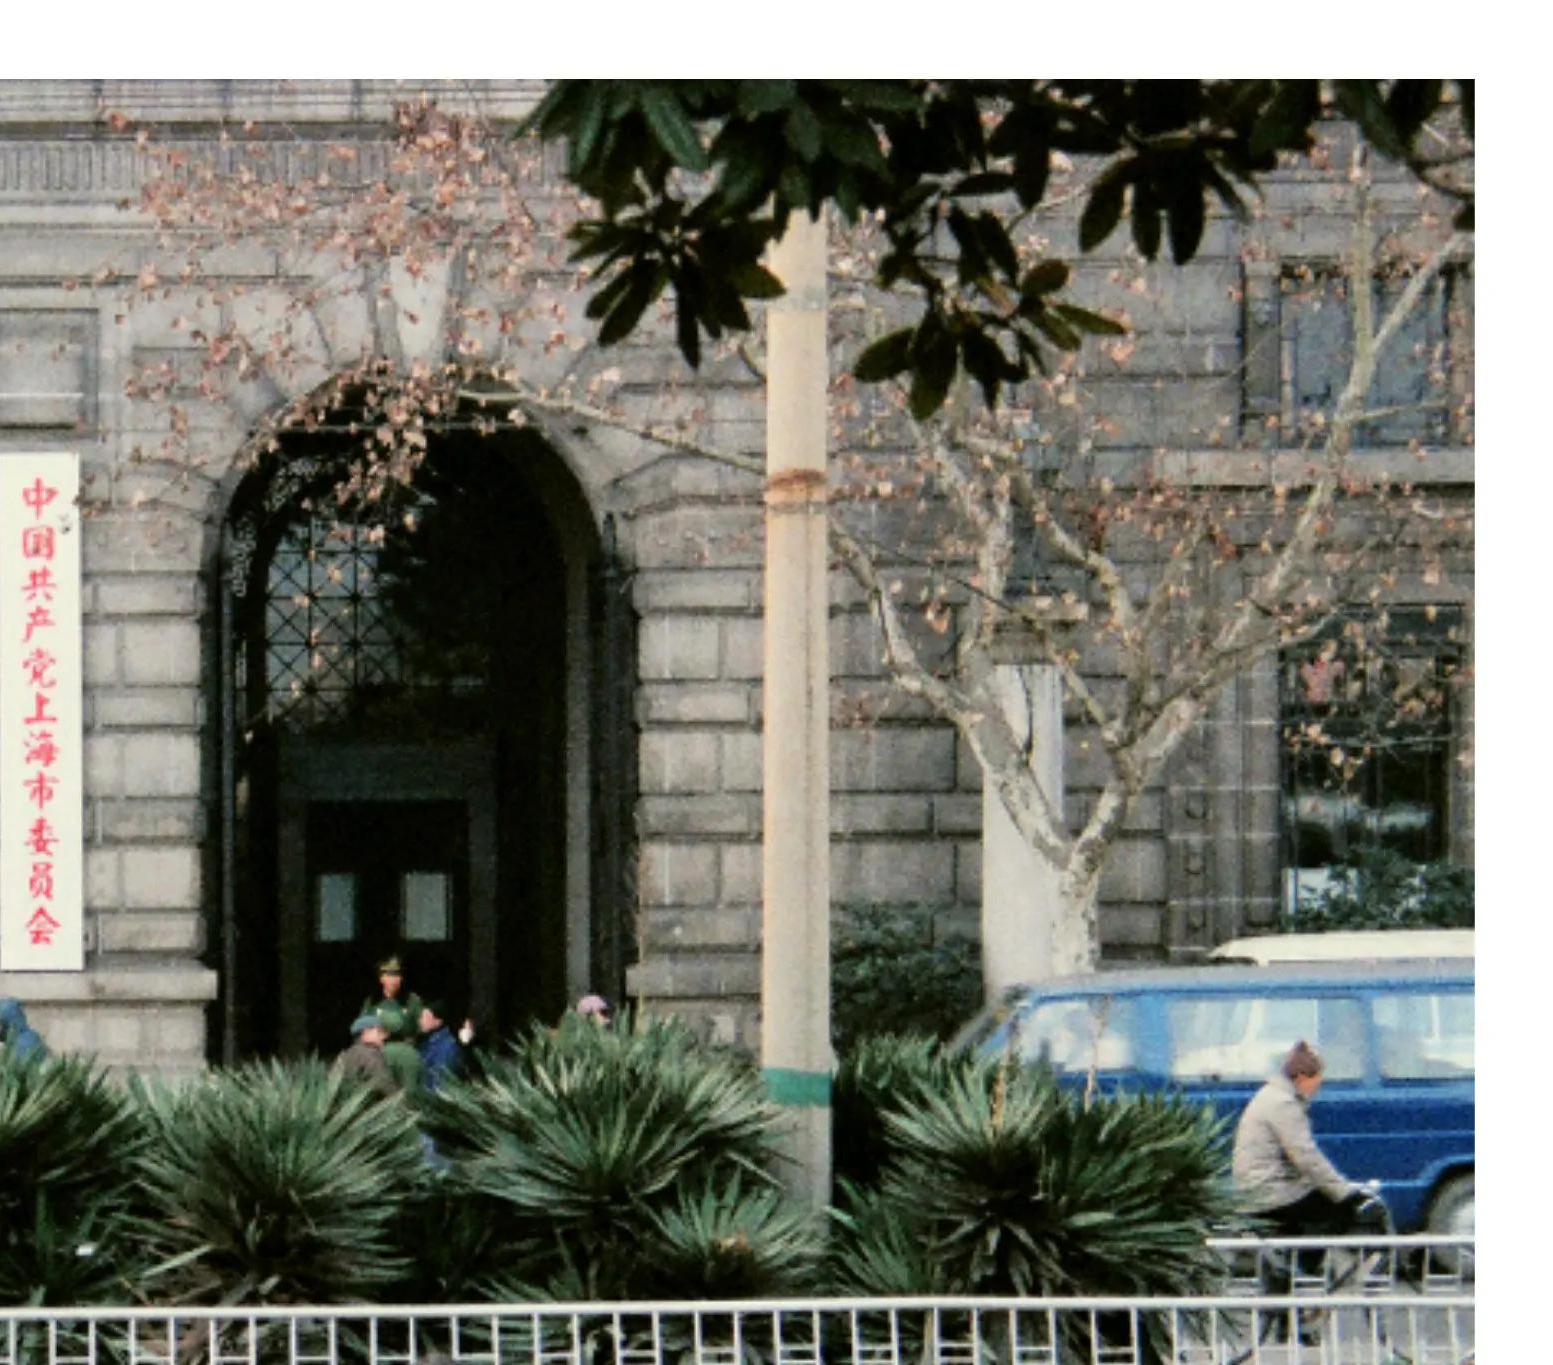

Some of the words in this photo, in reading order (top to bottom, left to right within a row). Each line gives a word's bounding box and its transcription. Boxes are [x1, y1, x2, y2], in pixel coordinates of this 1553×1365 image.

[22, 478, 61, 944] 中国共产党上海市委员会
